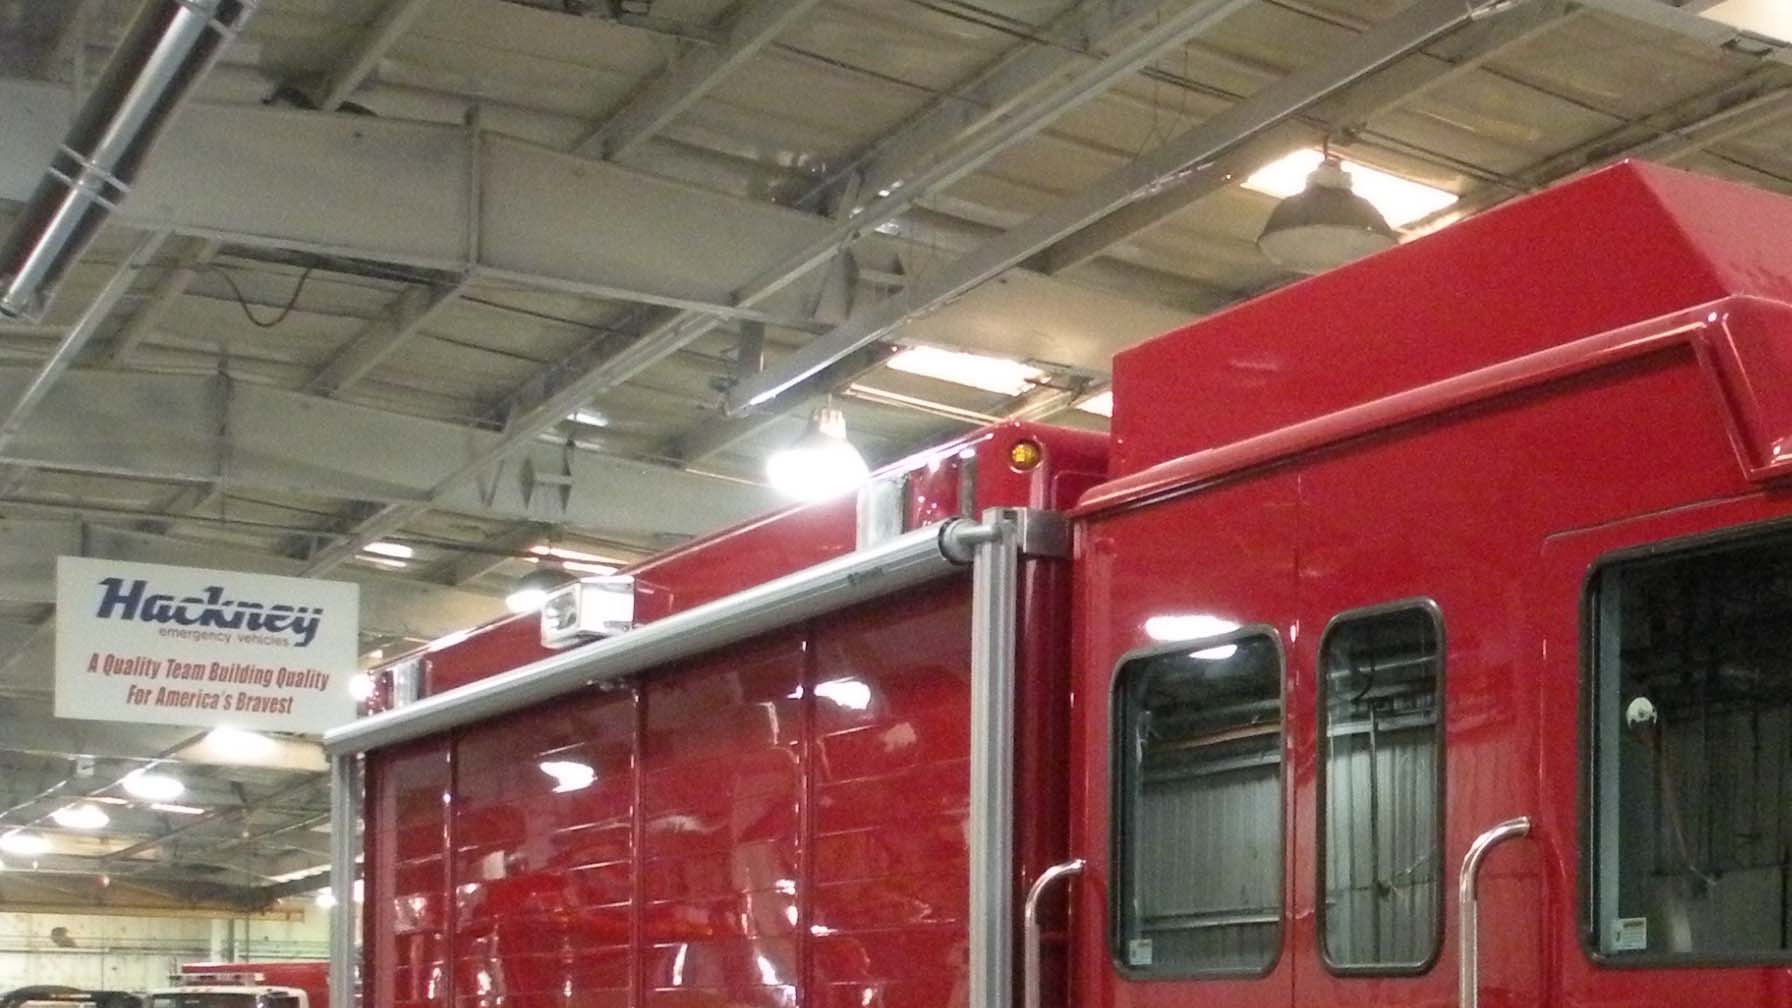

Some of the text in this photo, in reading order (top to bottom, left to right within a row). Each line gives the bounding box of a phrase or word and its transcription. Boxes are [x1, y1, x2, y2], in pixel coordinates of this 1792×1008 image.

[97, 577, 323, 647] Hackney
[158, 628, 289, 647] emergency vehicles
[87, 652, 330, 692] A Quality Team Building Quality
[126, 684, 294, 715] For America's Bravest
